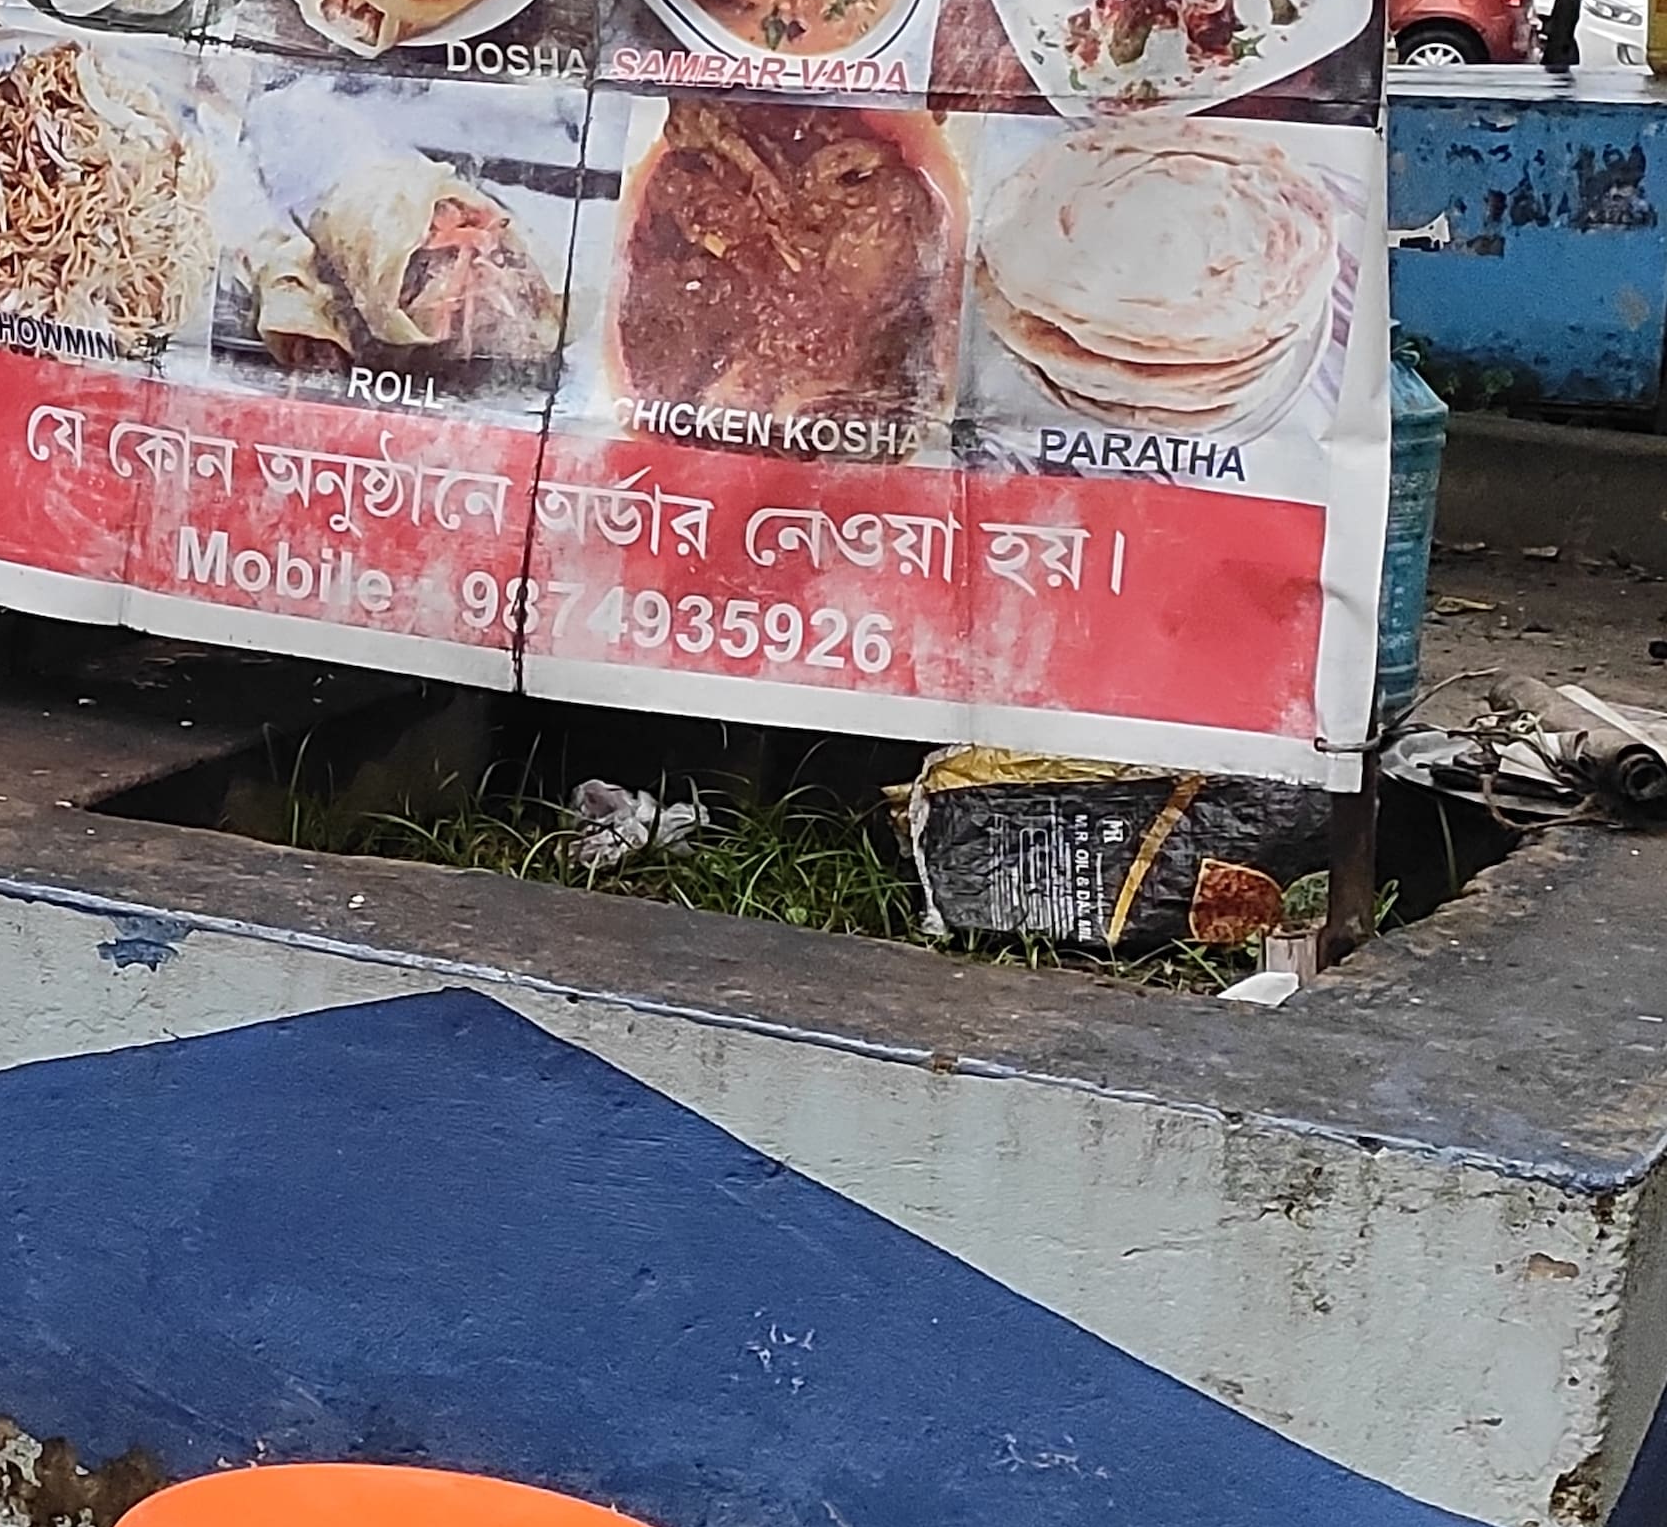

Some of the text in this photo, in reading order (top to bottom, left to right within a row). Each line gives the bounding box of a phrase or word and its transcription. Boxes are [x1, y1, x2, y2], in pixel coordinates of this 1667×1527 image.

[445, 39, 590, 77] DOSHA
[613, 47, 911, 96] SAMBAR VADA
[347, 365, 446, 412] ROLL
[615, 397, 923, 458] CHICKEN KOSHA
[1038, 427, 1247, 483] PARATHA
[25, 402, 87, 467] যে
[110, 418, 238, 501] কোন
[254, 429, 514, 539] অনুষ্ঠানে
[537, 466, 713, 560] অর্ডার
[745, 504, 959, 583] নেওয়া
[175, 525, 894, 674] Mobile 9874935926
